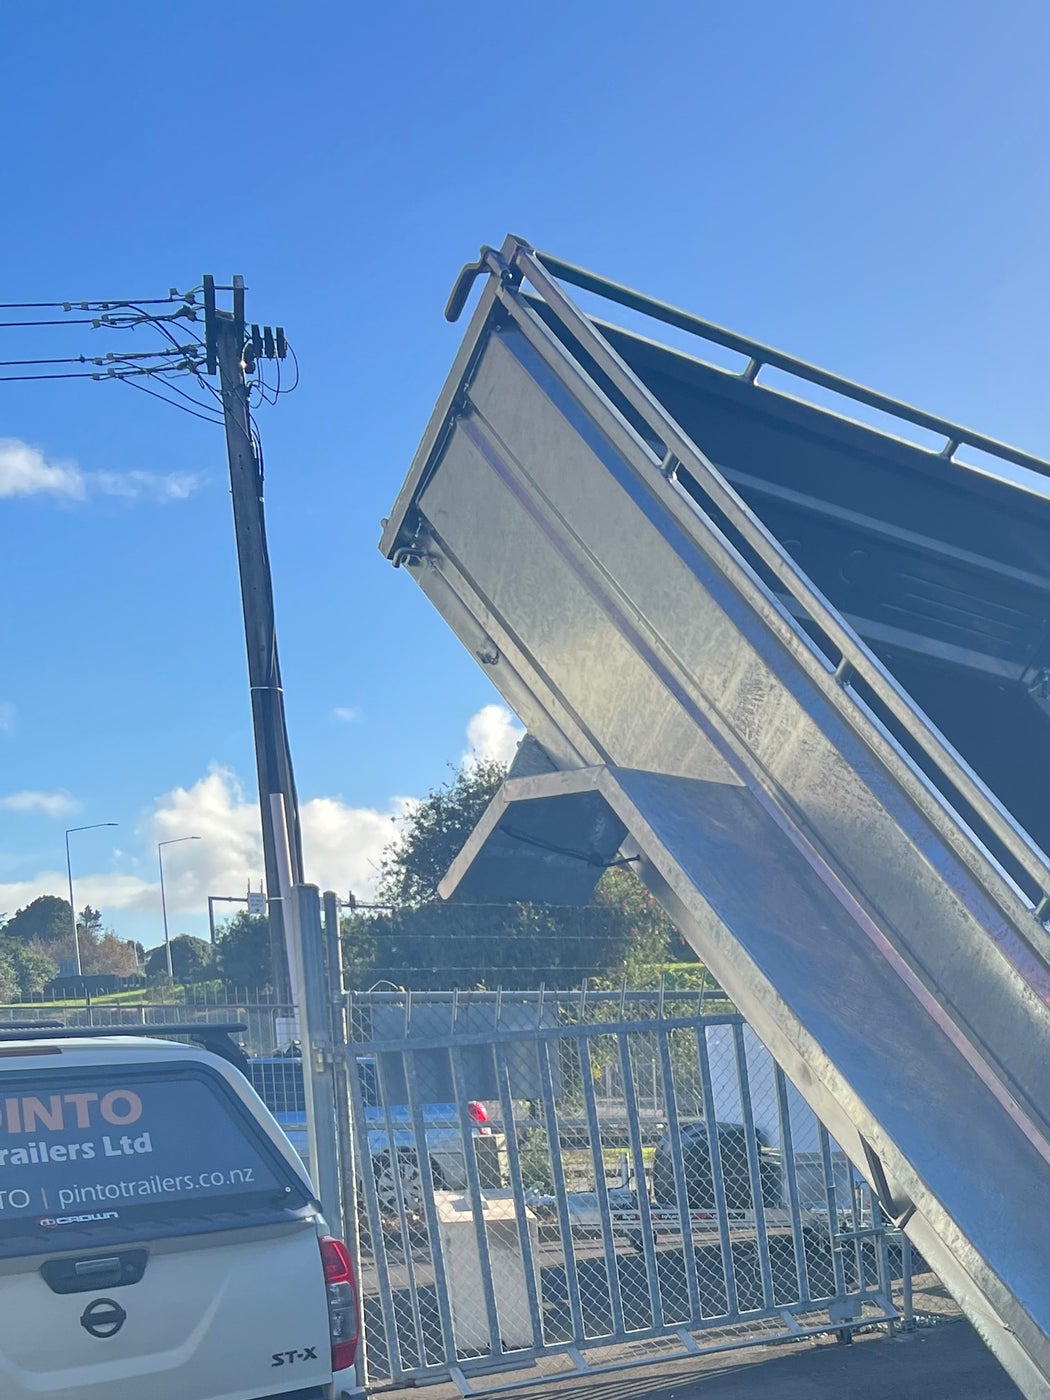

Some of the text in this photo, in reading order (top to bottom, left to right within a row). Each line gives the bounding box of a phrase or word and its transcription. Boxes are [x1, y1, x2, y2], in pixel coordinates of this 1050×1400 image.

[0, 1089, 143, 1134] INTO
[102, 1132, 153, 1157] Ltd
[58, 1167, 255, 1210] pintotrailers.co.nz
[271, 1346, 318, 1367] ST-X
